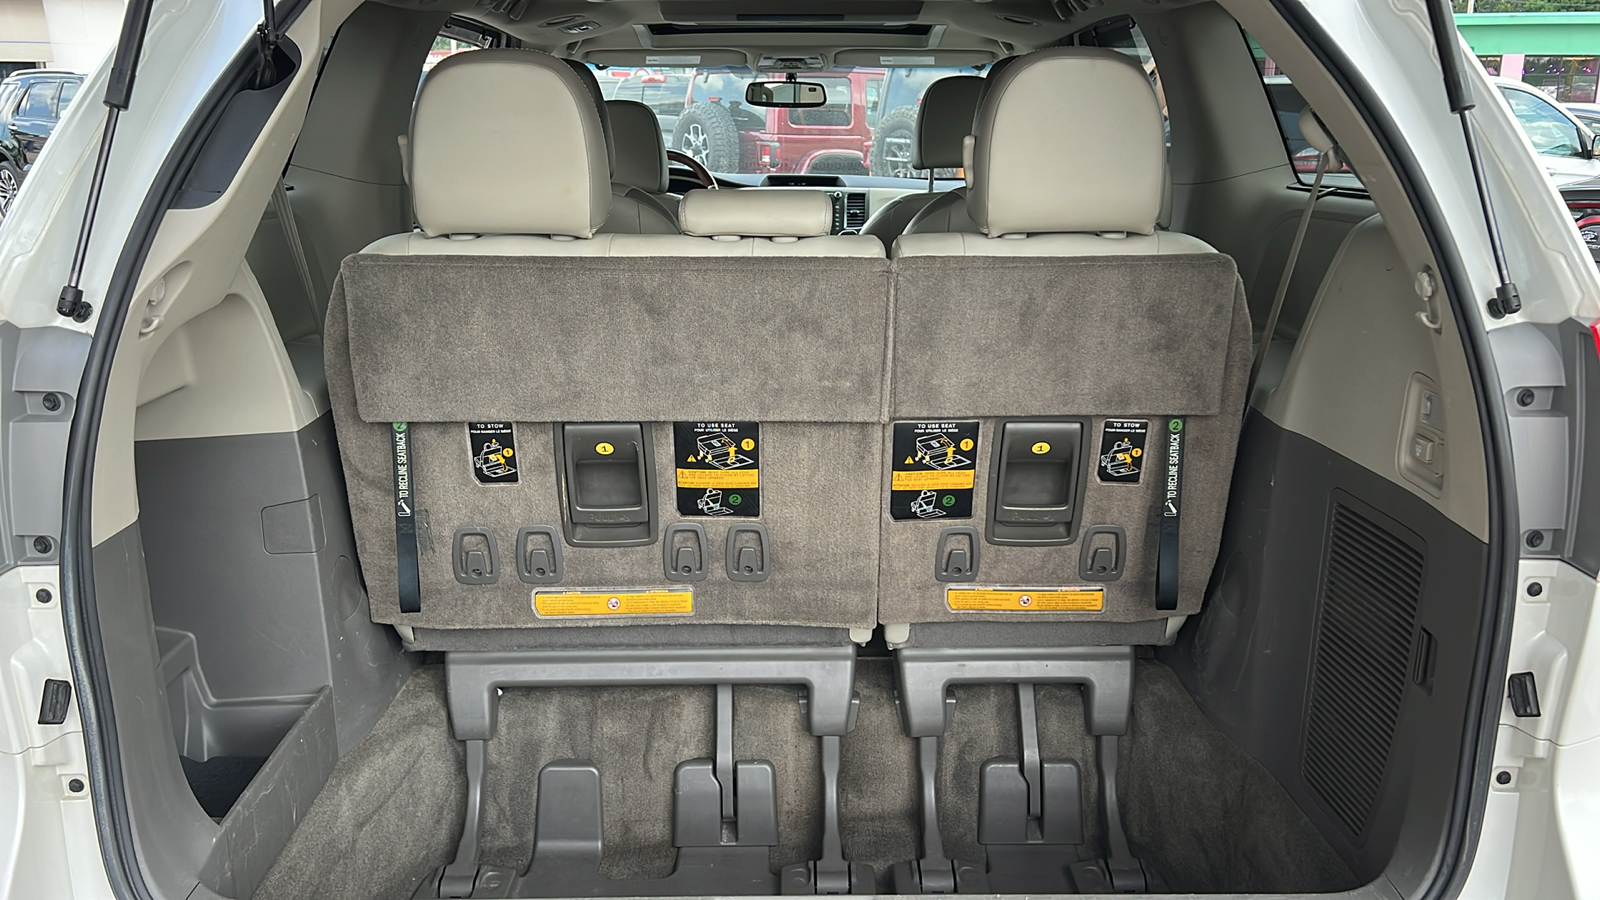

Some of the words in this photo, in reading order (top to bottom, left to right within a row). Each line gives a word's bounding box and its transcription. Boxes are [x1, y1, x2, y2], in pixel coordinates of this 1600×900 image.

[396, 432, 406, 464] SEATBACK
[1169, 433, 1180, 464] SEATBACK
[398, 464, 408, 490] RECLINE
[1168, 465, 1178, 490] RECLINE
[399, 490, 408, 498] TO
[1167, 490, 1177, 498] TO
[590, 514, 614, 522] PULL
